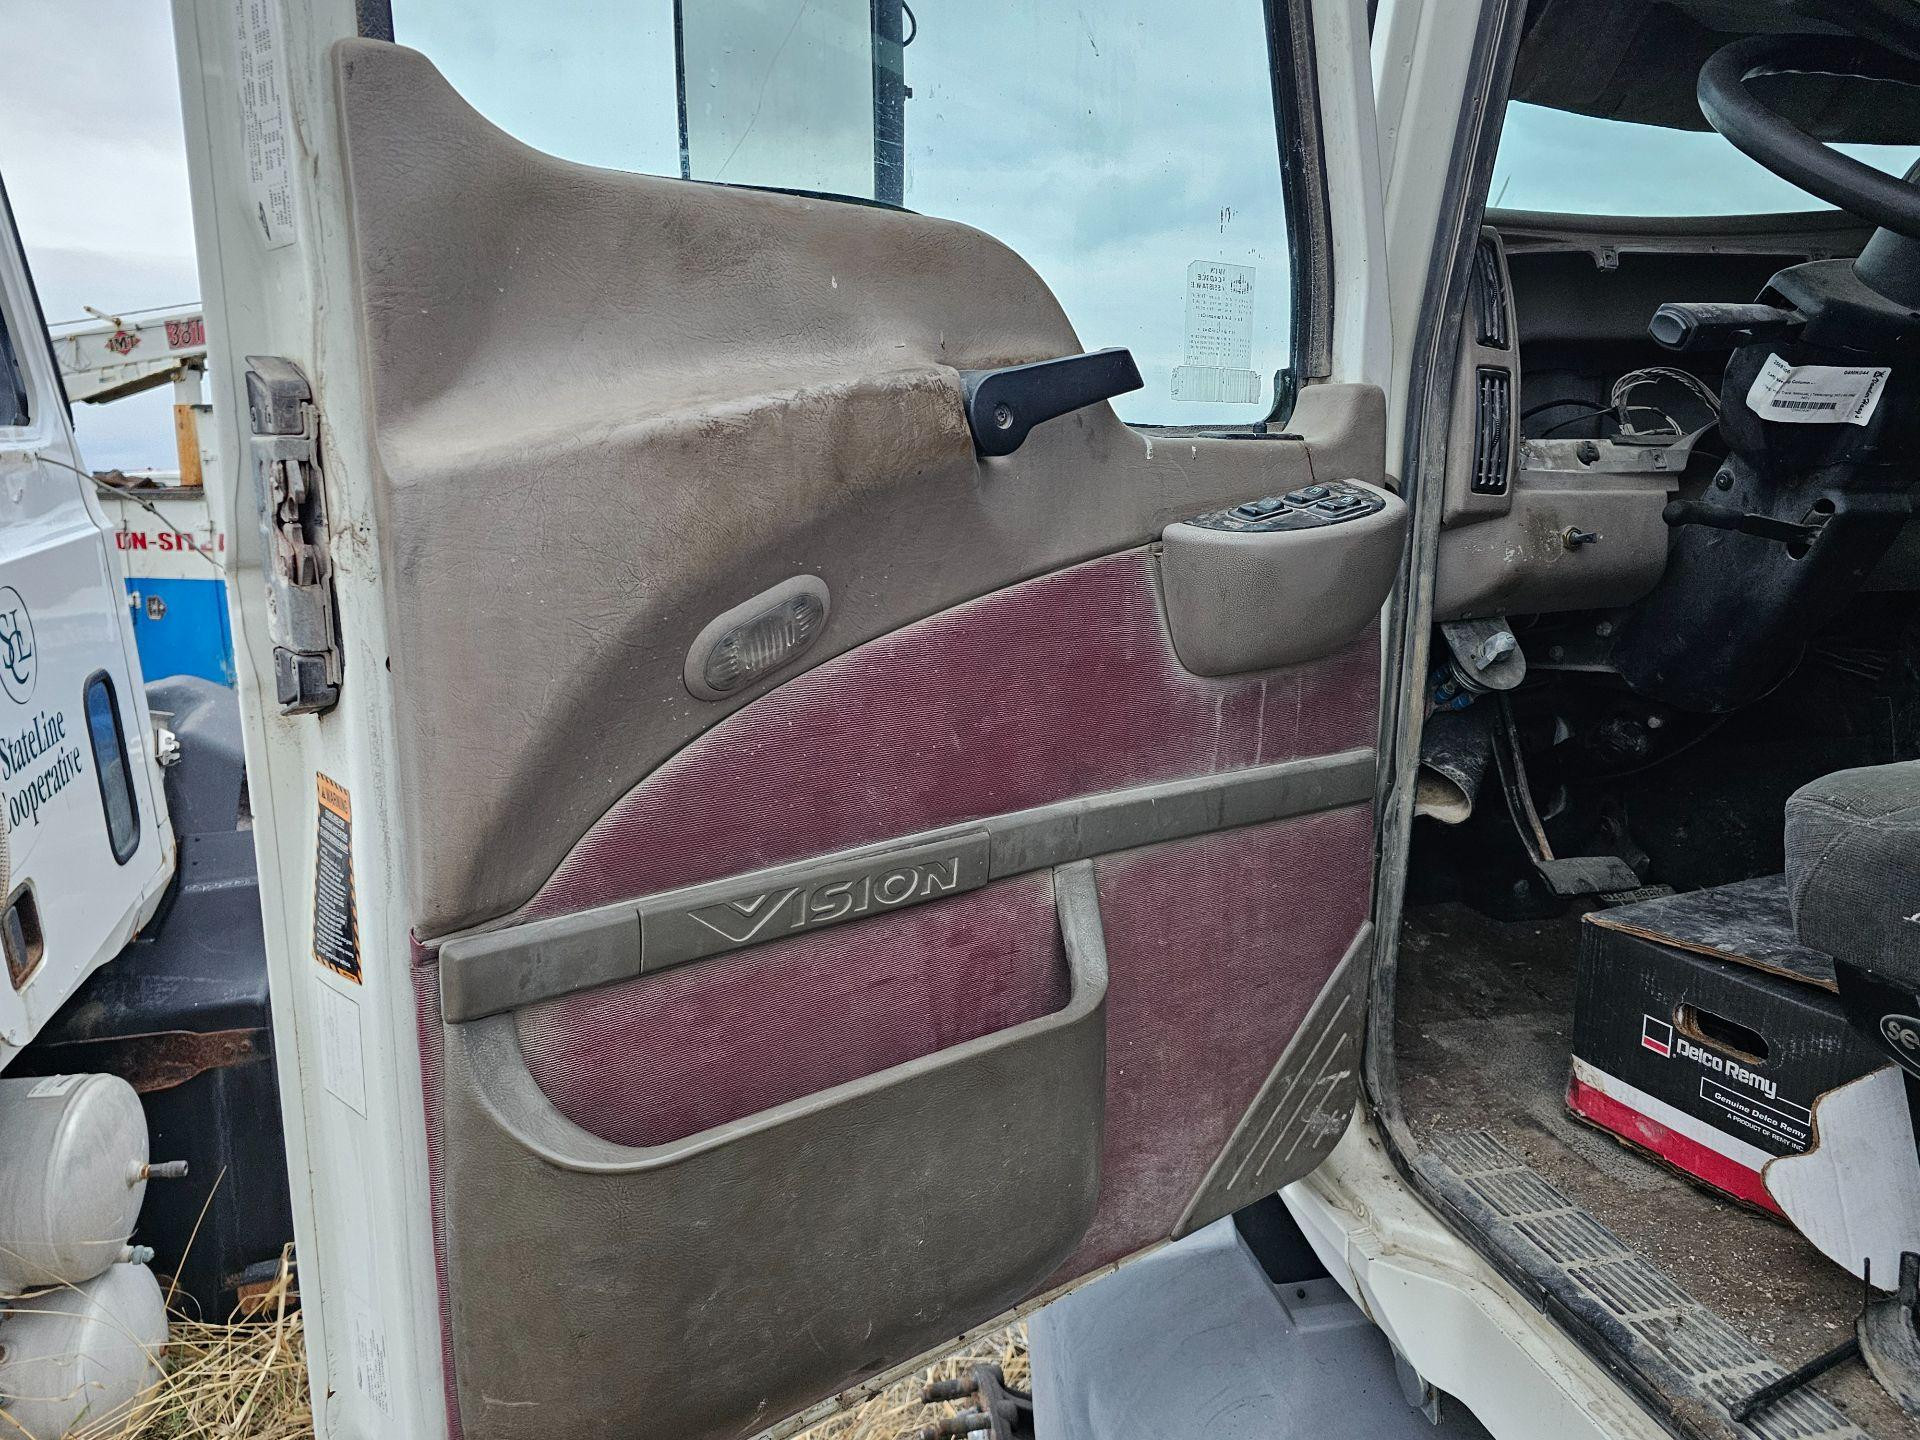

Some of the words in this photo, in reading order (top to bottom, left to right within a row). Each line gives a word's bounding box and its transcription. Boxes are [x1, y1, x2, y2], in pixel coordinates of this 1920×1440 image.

[687, 856, 960, 942] VISION
[1677, 1038, 1723, 1072] Delco
[1724, 1060, 1777, 1100] Remy
[1713, 1092, 1750, 1114] Genuine
[1751, 1109, 1778, 1127] Delco
[1780, 1121, 1807, 1140] Remy
[1732, 1115, 1762, 1133] PRODUCT
[1762, 1127, 1771, 1137] OF
[1771, 1132, 1791, 1147] REMY
